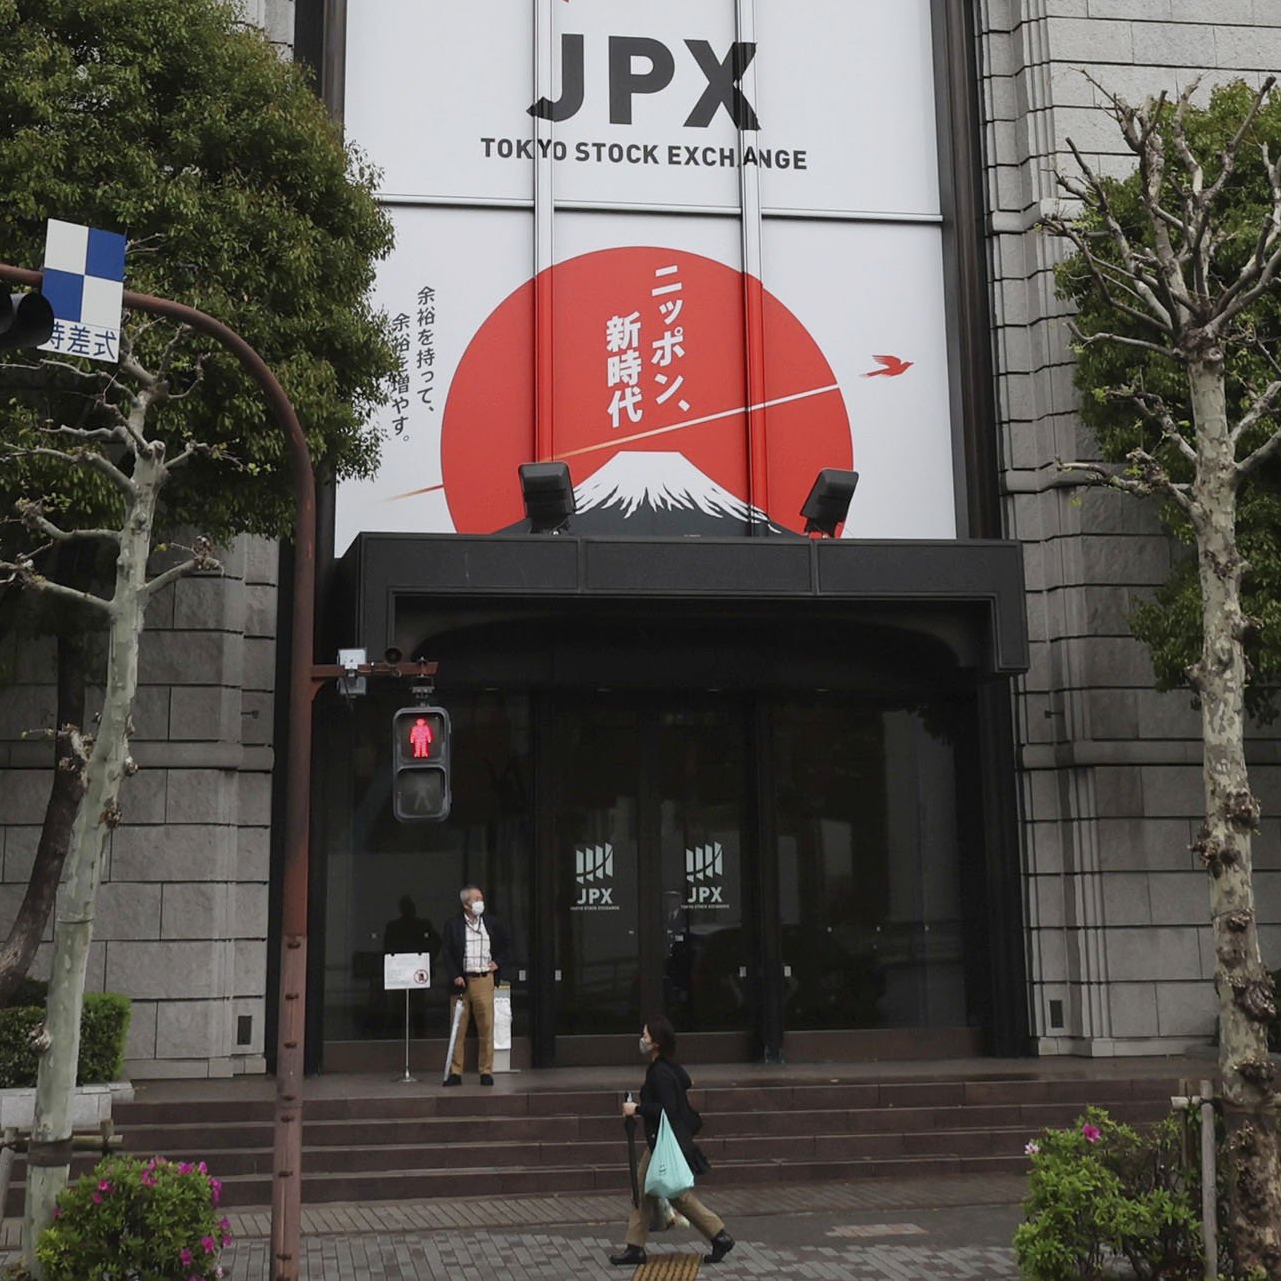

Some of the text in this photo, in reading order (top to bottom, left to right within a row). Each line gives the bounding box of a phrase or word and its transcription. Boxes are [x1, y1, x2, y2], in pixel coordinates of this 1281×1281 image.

[526, 33, 761, 131] JPX
[481, 137, 808, 170] TOKYO STOCK EXCHANGE
[417, 286, 435, 412] 余裕を持って、
[606, 311, 643, 428] 新時代
[651, 265, 690, 412] ニッポン、
[577, 888, 613, 904] JPX
[687, 887, 723, 903] JPX
